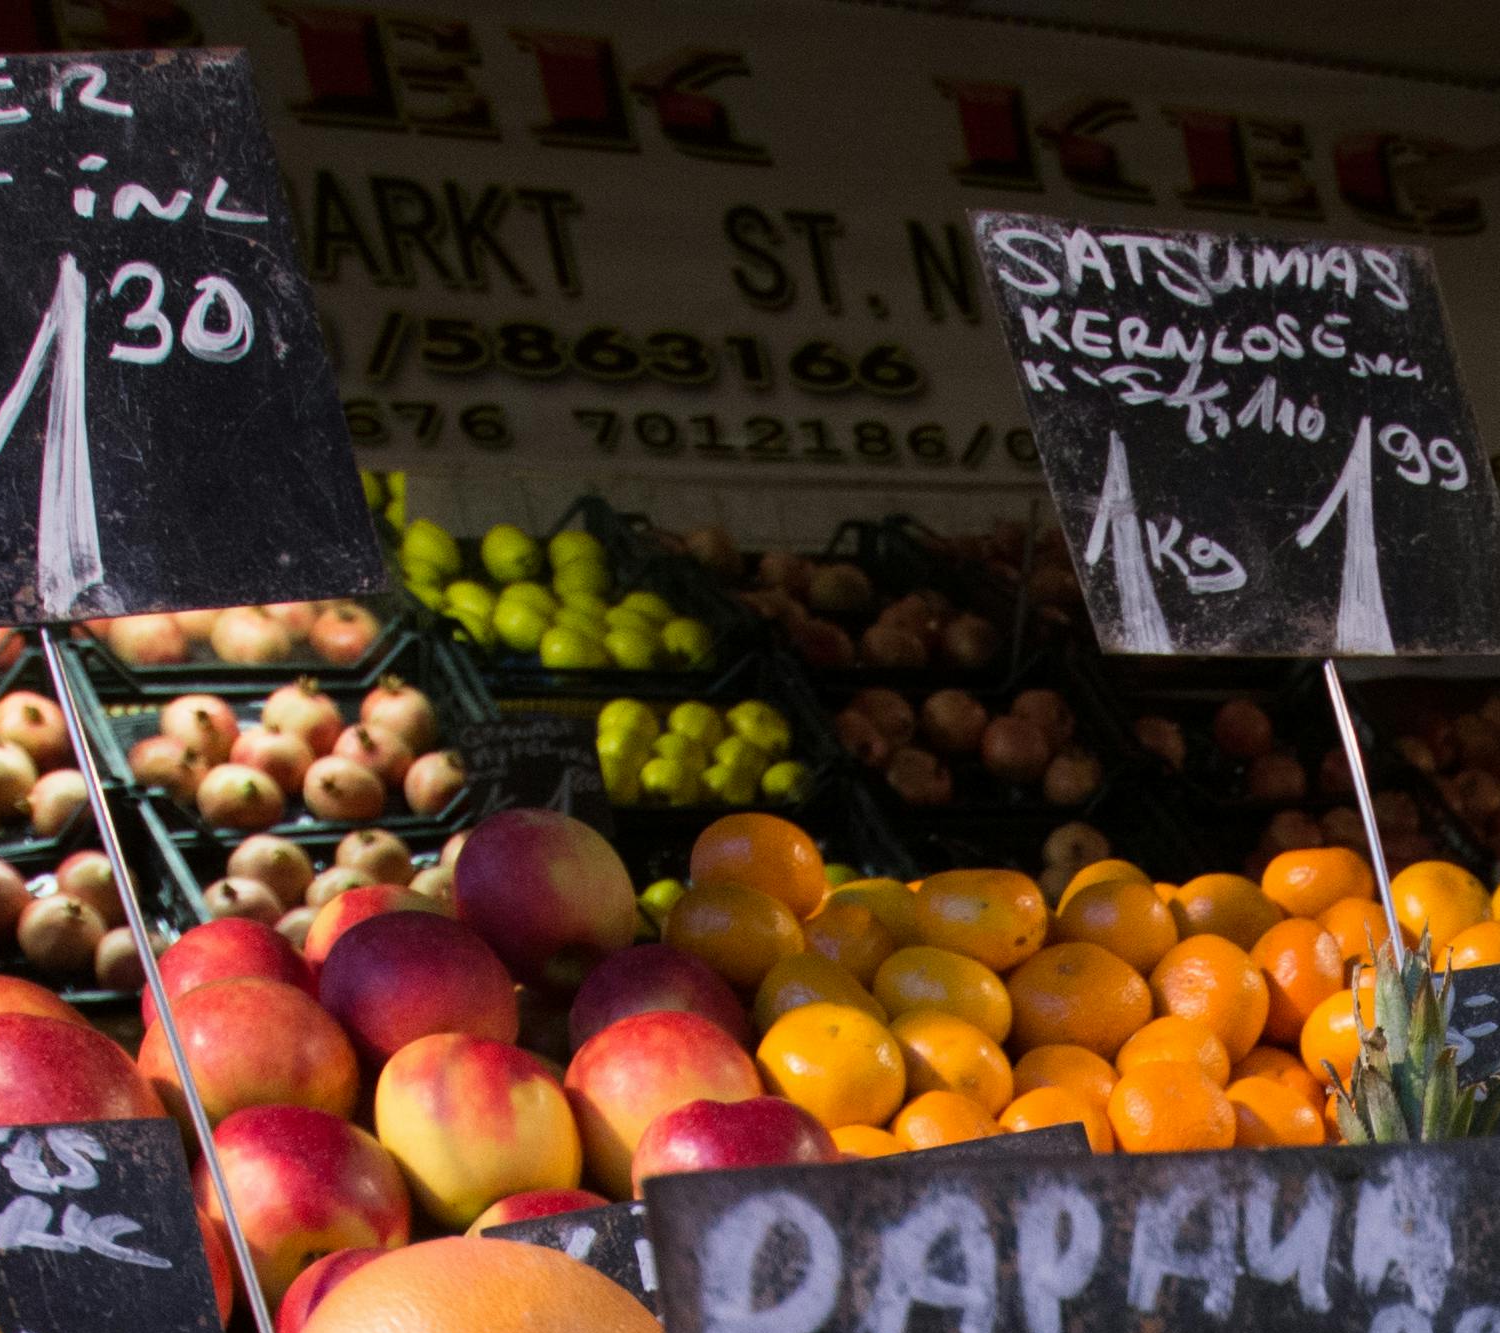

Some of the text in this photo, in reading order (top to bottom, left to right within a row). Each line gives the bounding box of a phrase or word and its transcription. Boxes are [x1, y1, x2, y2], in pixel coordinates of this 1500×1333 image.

[307, 168, 586, 297] ARKT
[993, 227, 1409, 310] SATSUMAS
[367, 308, 928, 400] /5863166
[1021, 305, 1351, 363] KERNLOSE
